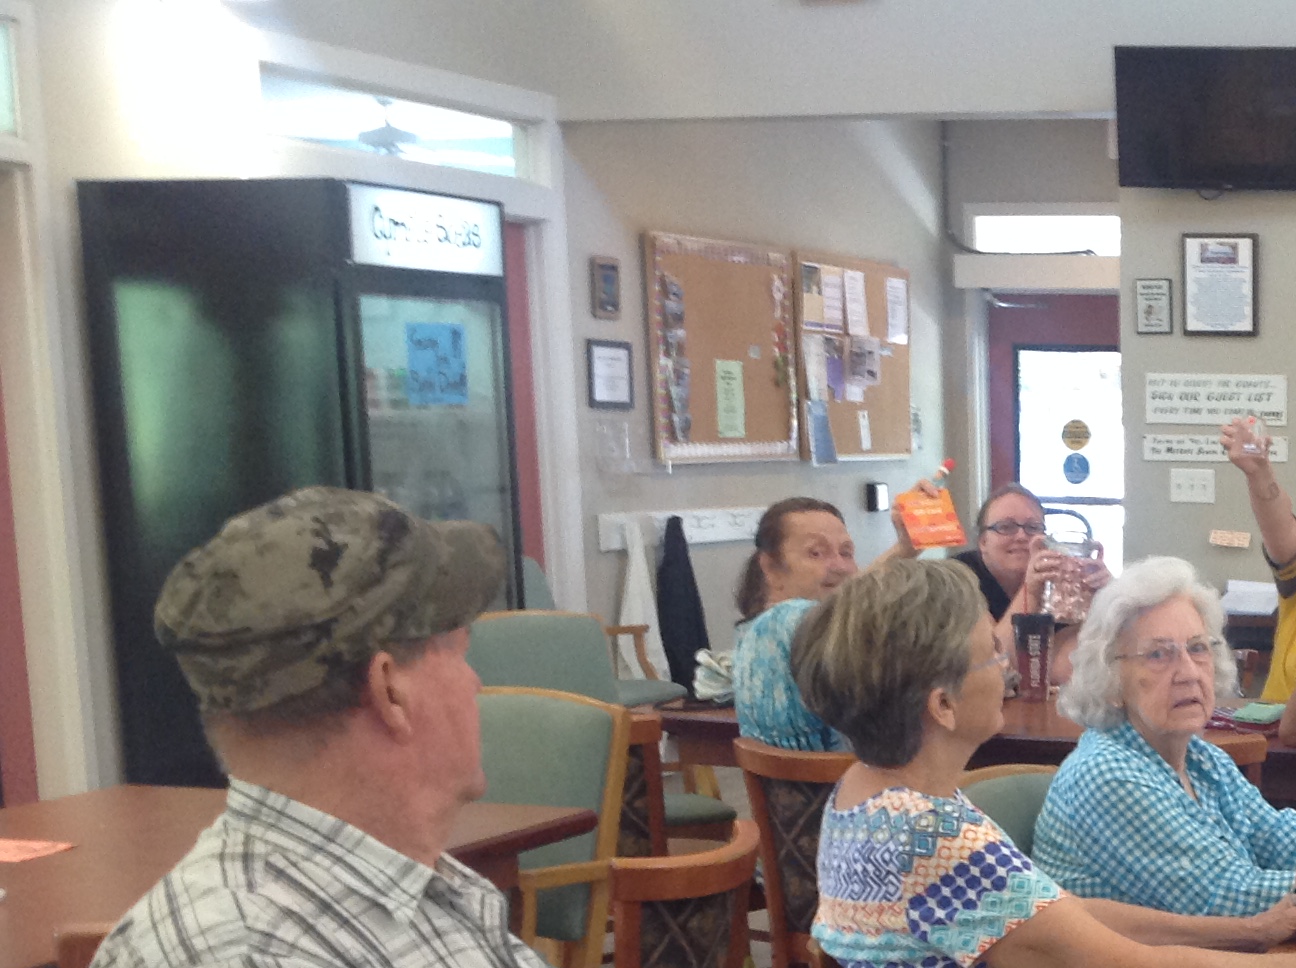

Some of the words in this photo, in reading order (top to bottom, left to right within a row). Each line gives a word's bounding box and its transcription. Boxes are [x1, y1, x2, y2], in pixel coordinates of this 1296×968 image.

[1150, 391, 1174, 401] SIGN
[1179, 391, 1200, 402] OUR
[1206, 391, 1242, 402] GUEST
[1247, 392, 1273, 402] LIST
